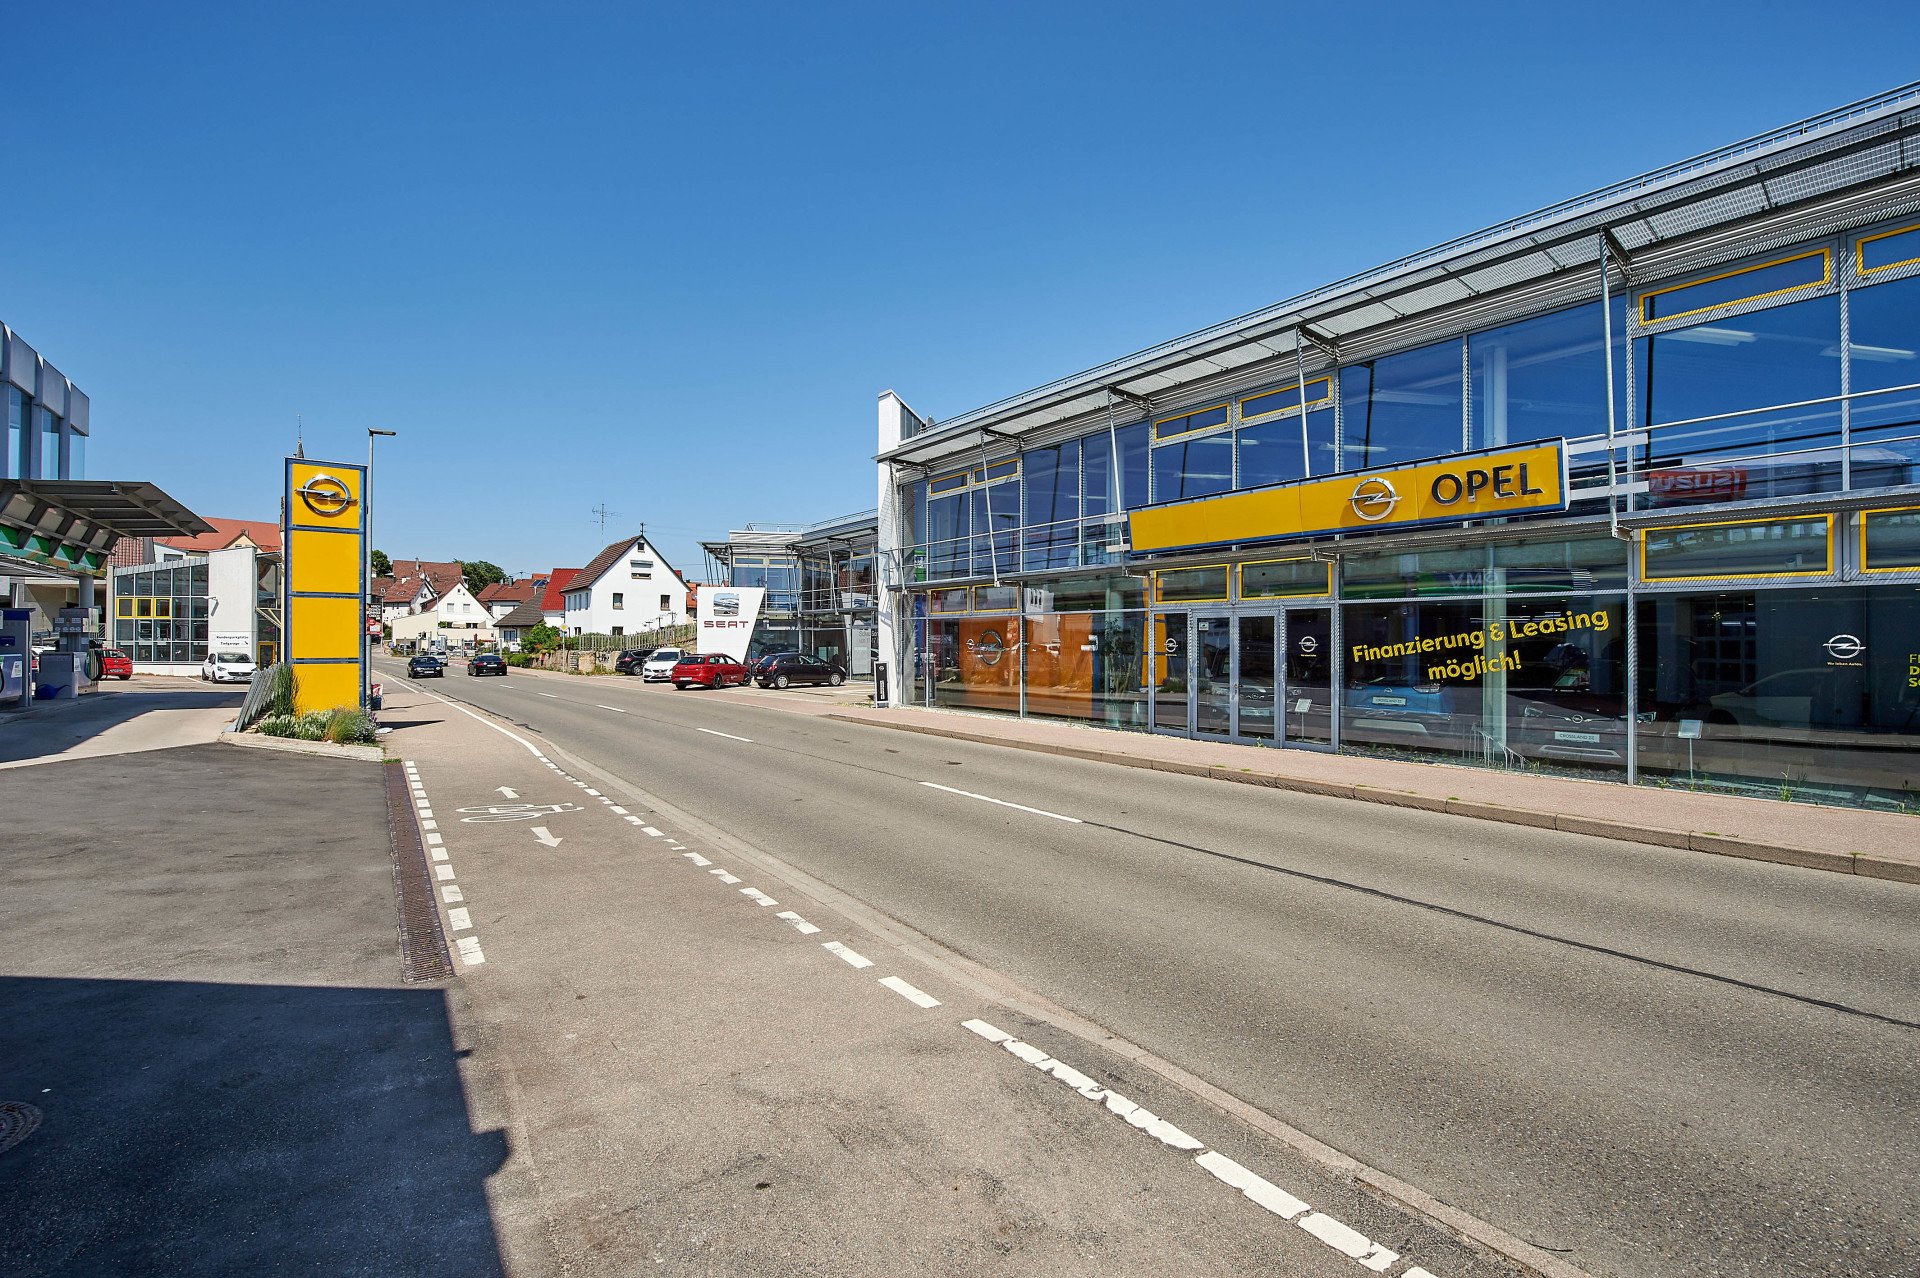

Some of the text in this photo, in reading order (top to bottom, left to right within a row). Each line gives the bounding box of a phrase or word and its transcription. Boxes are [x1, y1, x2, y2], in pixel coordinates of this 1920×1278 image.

[1431, 462, 1544, 506] OPEL
[703, 620, 749, 629] SEAT
[1352, 610, 1610, 663] Finanzierung & Leasing
[1427, 650, 1523, 681] möglich!
